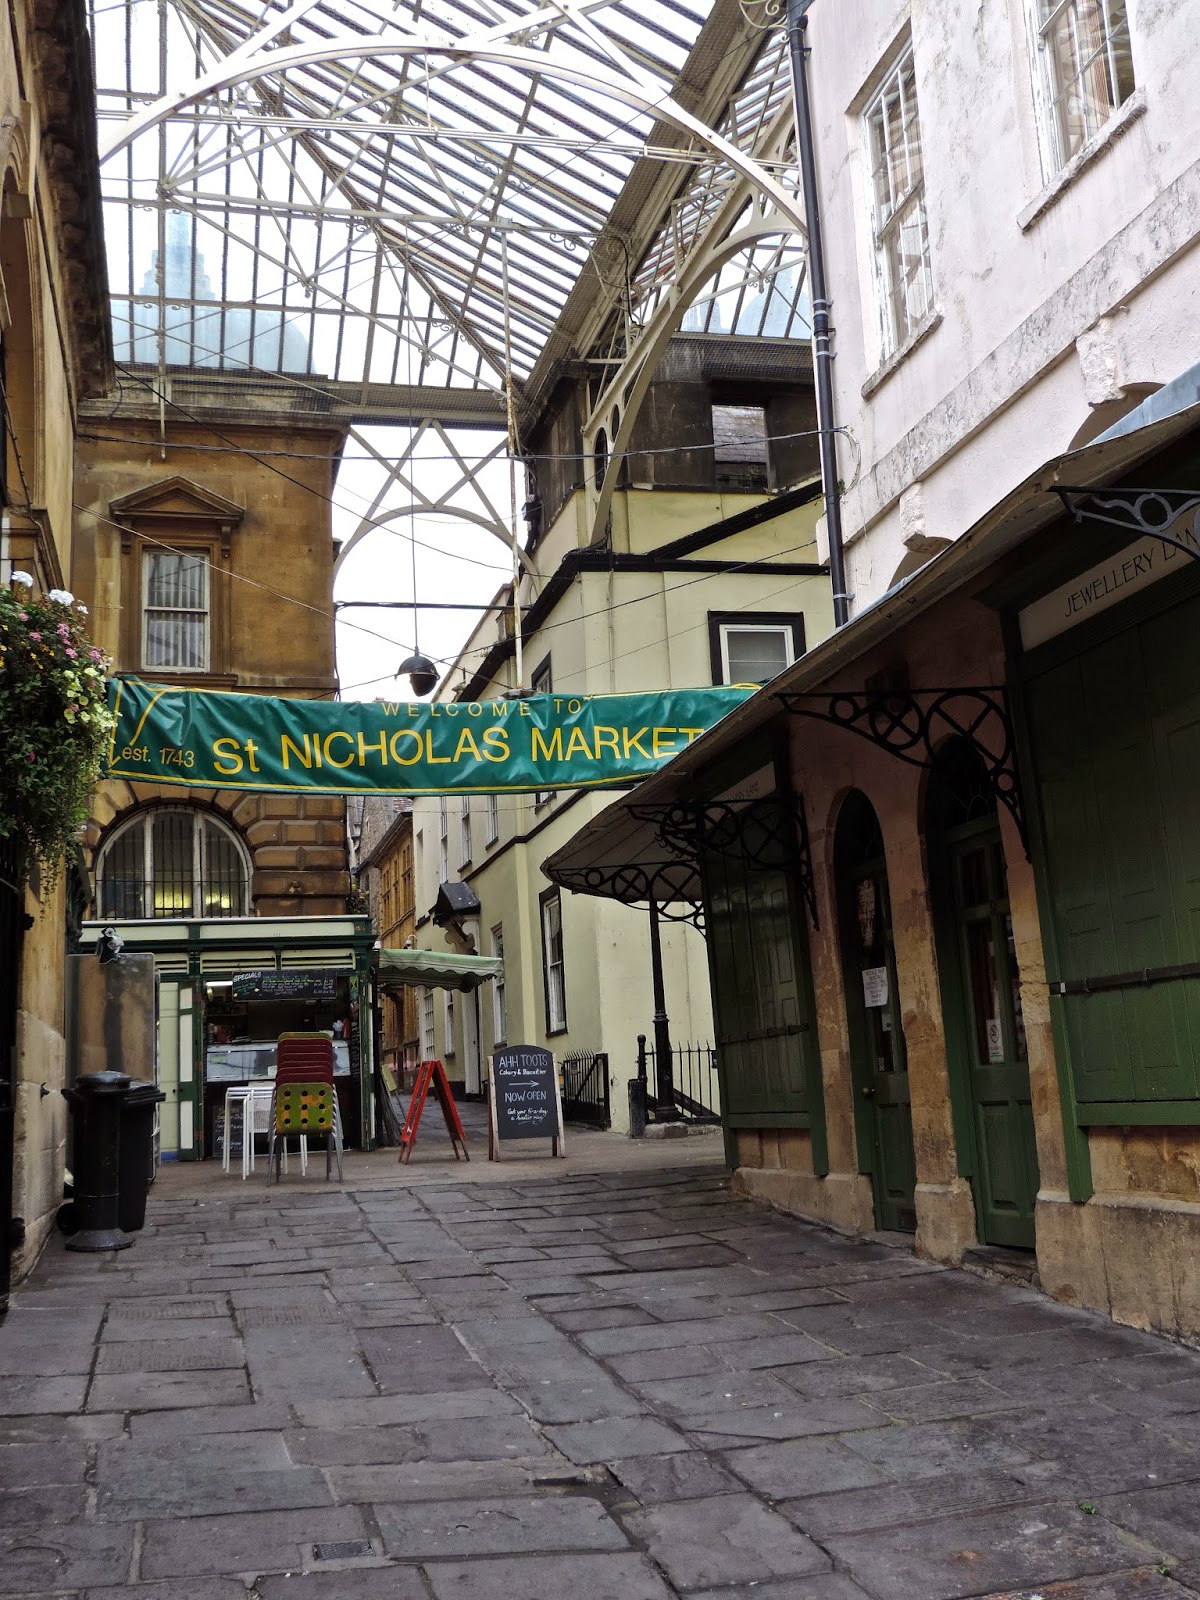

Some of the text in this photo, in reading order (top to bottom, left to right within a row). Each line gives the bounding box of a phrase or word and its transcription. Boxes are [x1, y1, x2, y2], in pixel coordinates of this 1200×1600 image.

[1065, 549, 1154, 617] JEWELLERY
[382, 698, 582, 717] WELCOME TO
[121, 745, 195, 768] est. 1743
[213, 737, 260, 774] St
[281, 726, 511, 770] NICHOLAS
[233, 972, 261, 982] SPECIALS
[499, 1054, 547, 1067] AHH TOOTS
[505, 1090, 546, 1102] NOW OPEN
